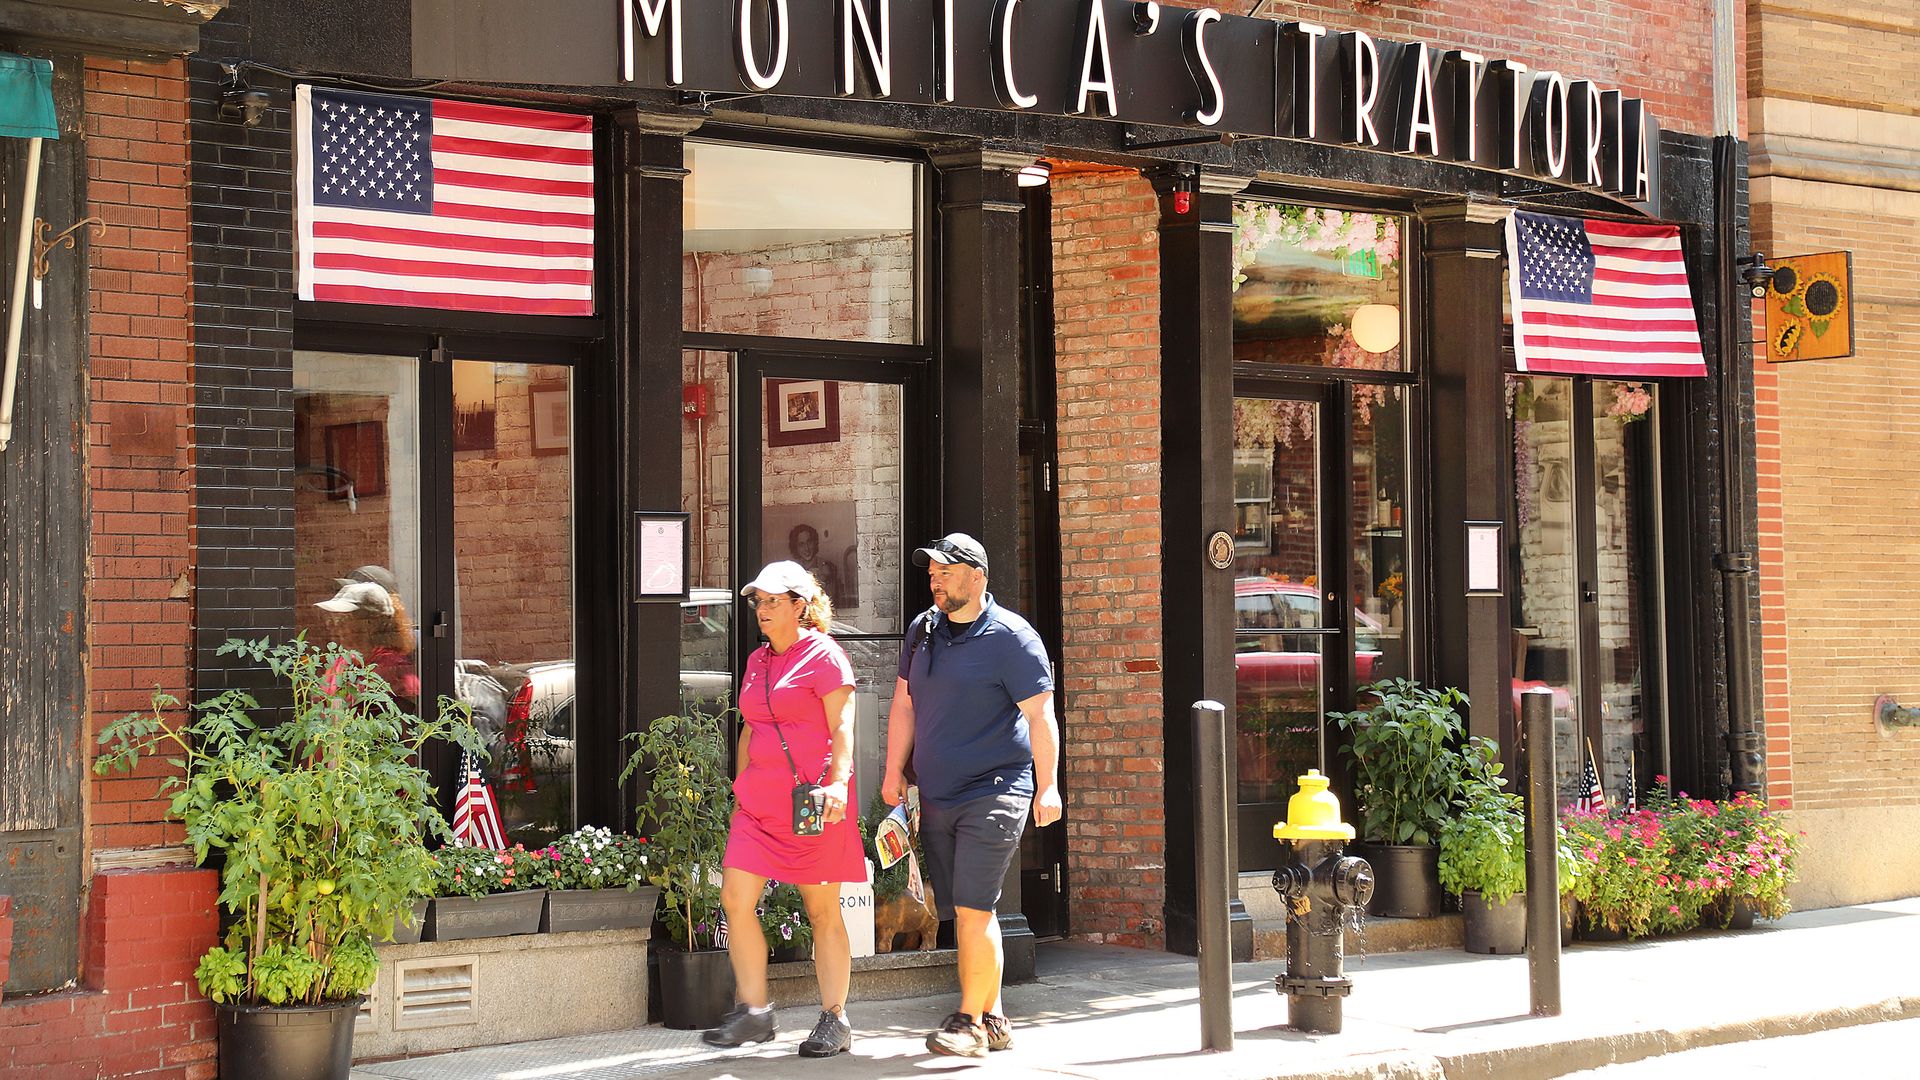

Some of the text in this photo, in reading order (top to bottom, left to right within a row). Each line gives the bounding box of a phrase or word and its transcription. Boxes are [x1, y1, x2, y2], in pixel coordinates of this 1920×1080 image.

[617, 0, 1651, 203] MONICA'S TRATTORIA
[839, 895, 871, 908] RONI
